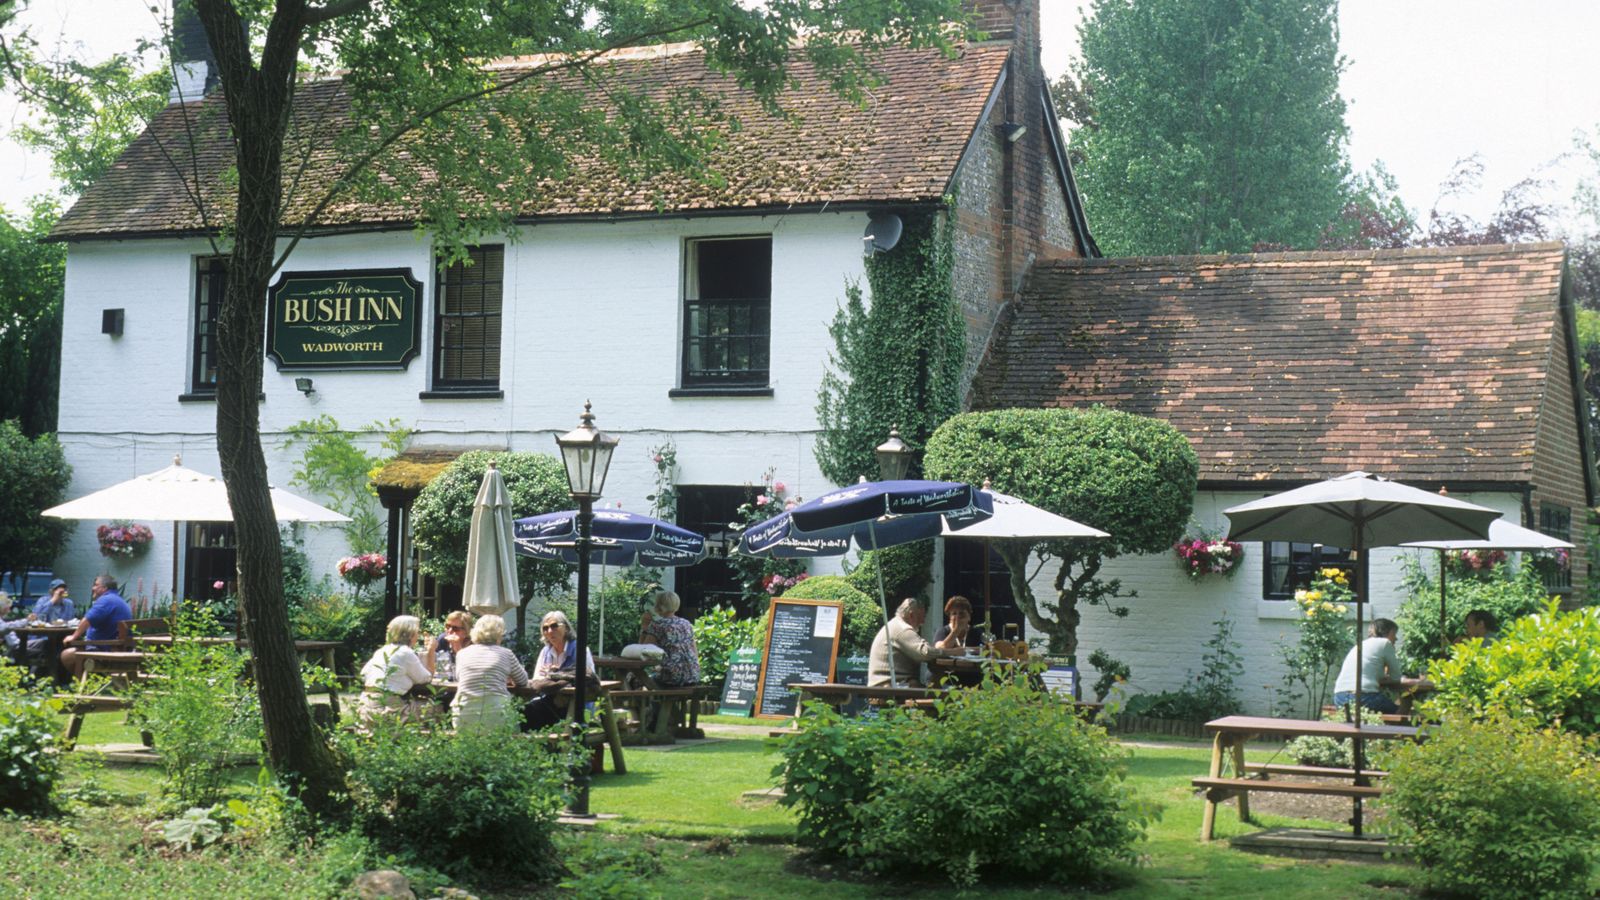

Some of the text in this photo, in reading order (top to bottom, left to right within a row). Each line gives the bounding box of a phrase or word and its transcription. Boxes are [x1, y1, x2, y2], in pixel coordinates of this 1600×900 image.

[334, 281, 352, 294] The
[284, 296, 403, 323] BUSH INN
[302, 342, 383, 352] WADWORTH
